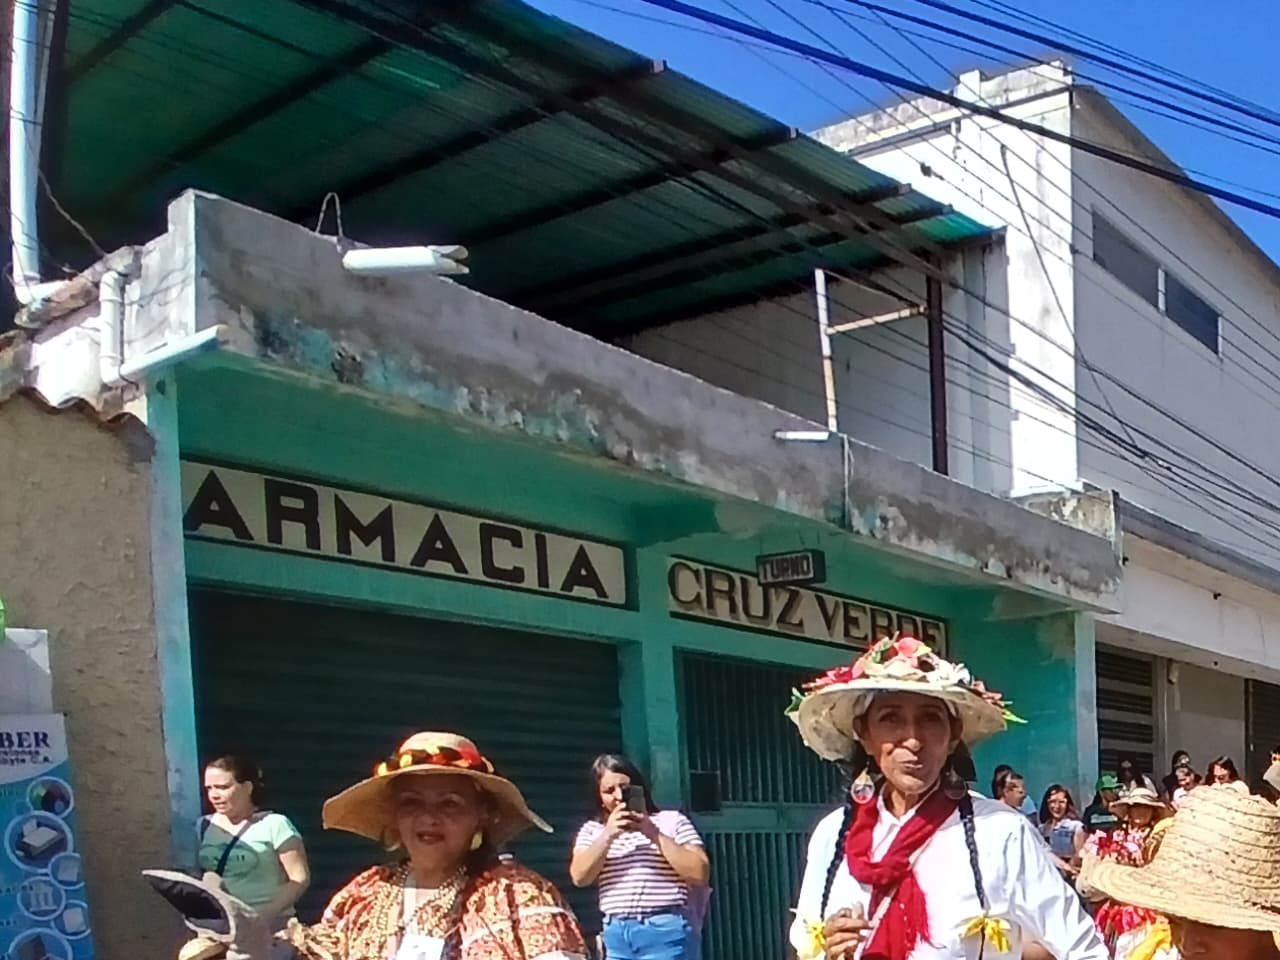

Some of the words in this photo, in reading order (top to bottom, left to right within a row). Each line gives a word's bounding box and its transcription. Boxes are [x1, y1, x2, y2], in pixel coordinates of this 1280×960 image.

[761, 552, 811, 581] TURNO
[667, 561, 804, 628] CRUZ
[0, 731, 50, 749] BER
